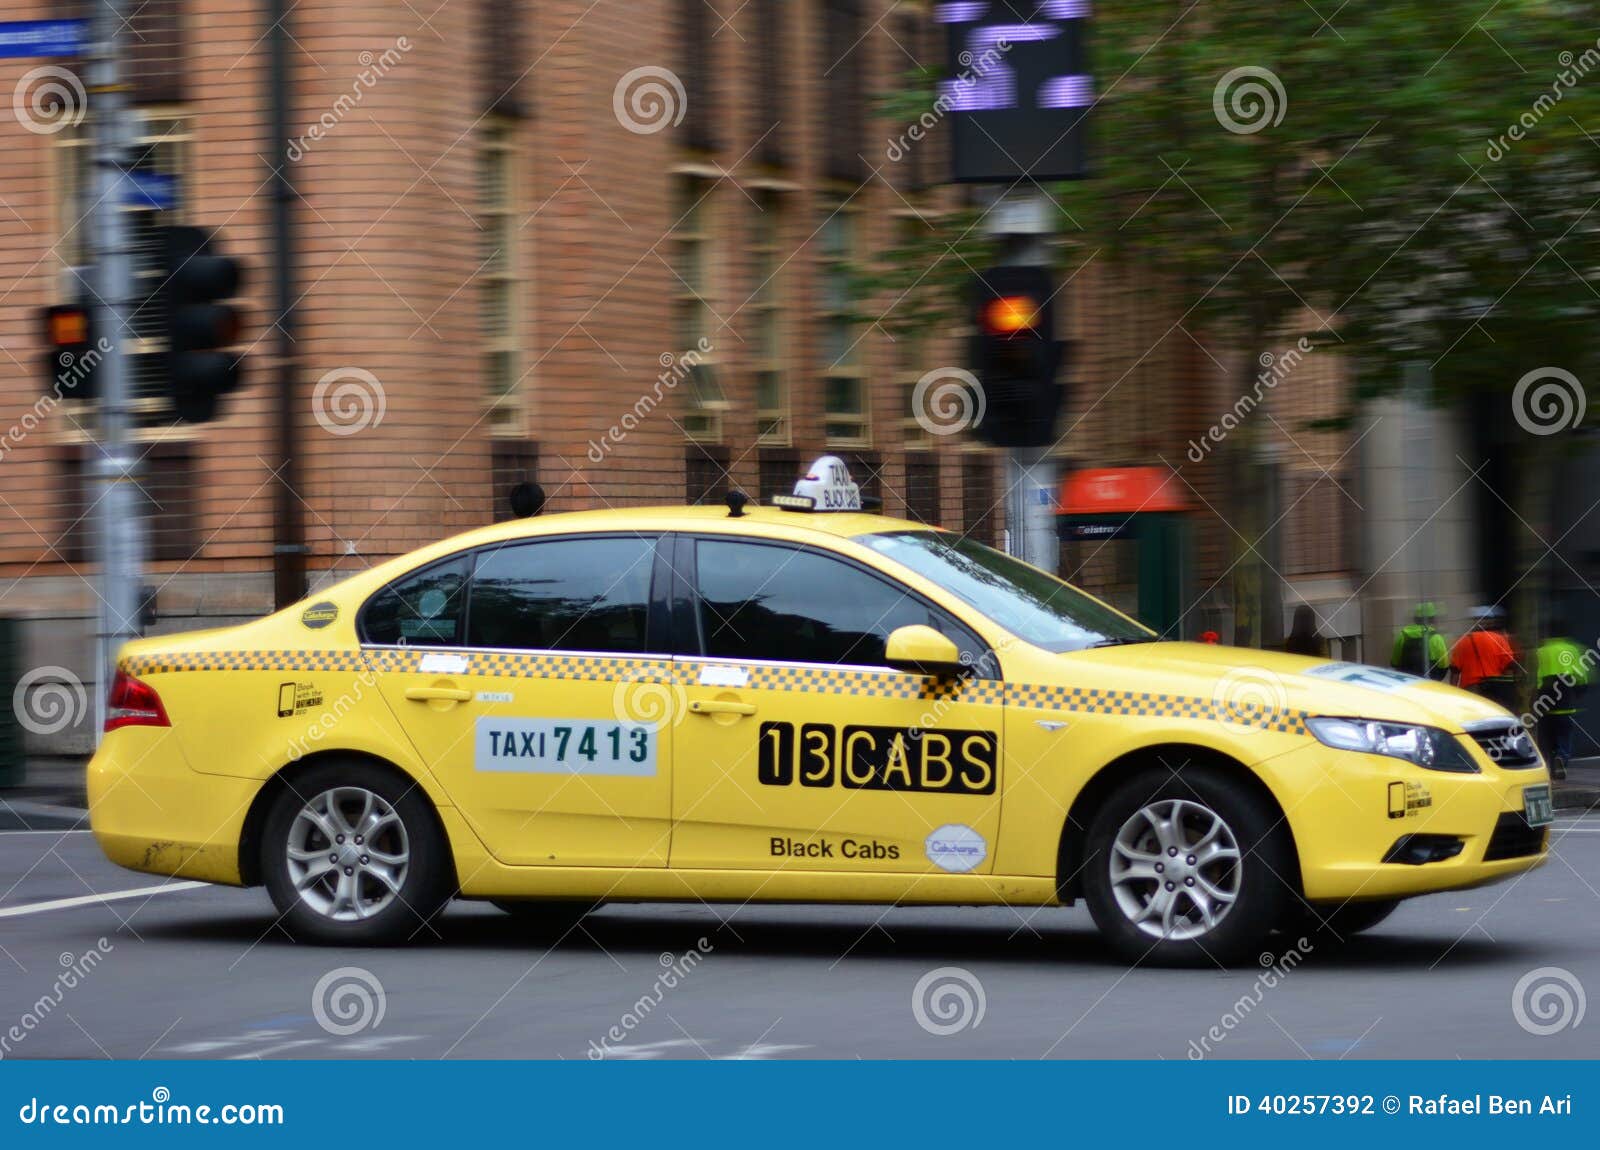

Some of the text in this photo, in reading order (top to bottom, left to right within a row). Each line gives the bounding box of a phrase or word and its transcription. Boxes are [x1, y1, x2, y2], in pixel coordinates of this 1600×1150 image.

[489, 726, 648, 763] TAXI 7413
[770, 837, 900, 859] Black Cabs
